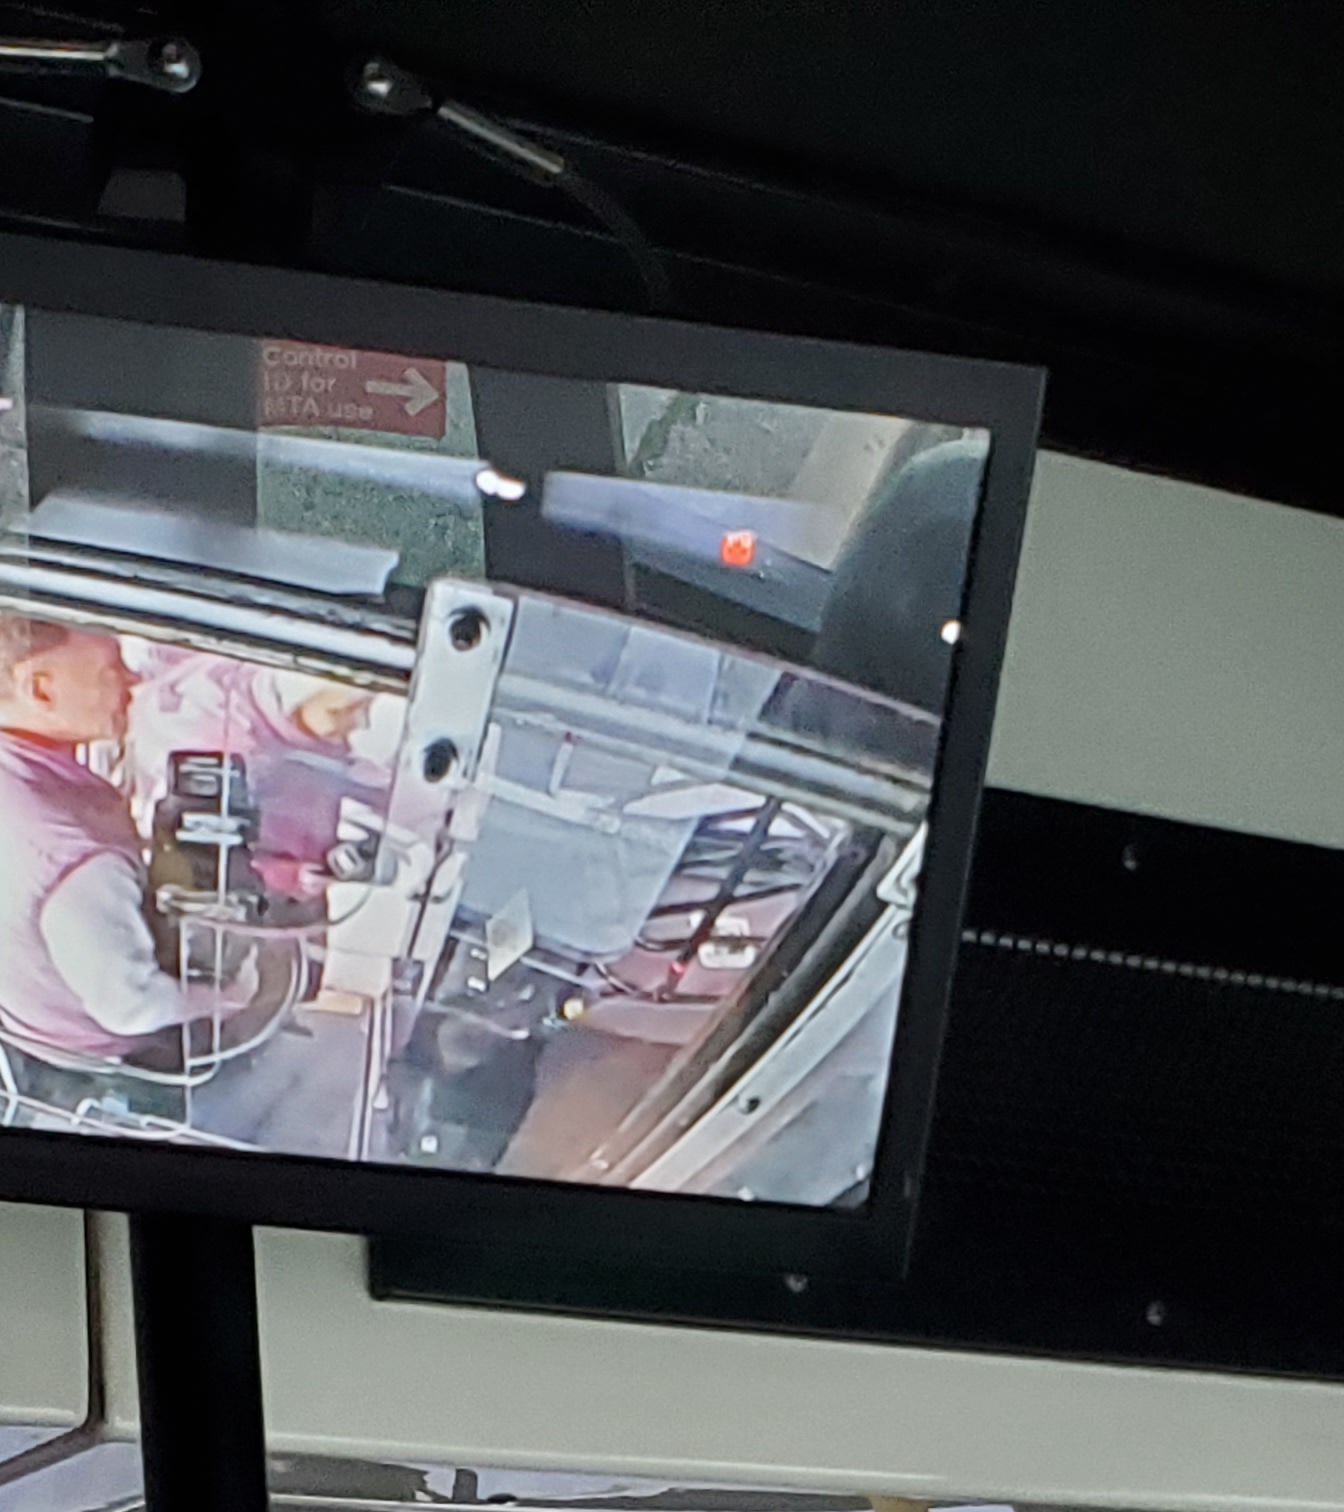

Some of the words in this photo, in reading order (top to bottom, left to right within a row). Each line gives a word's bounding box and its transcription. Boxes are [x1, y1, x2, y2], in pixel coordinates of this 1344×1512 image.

[263, 346, 356, 369] Control
[301, 371, 337, 392] for
[328, 403, 374, 420] use
